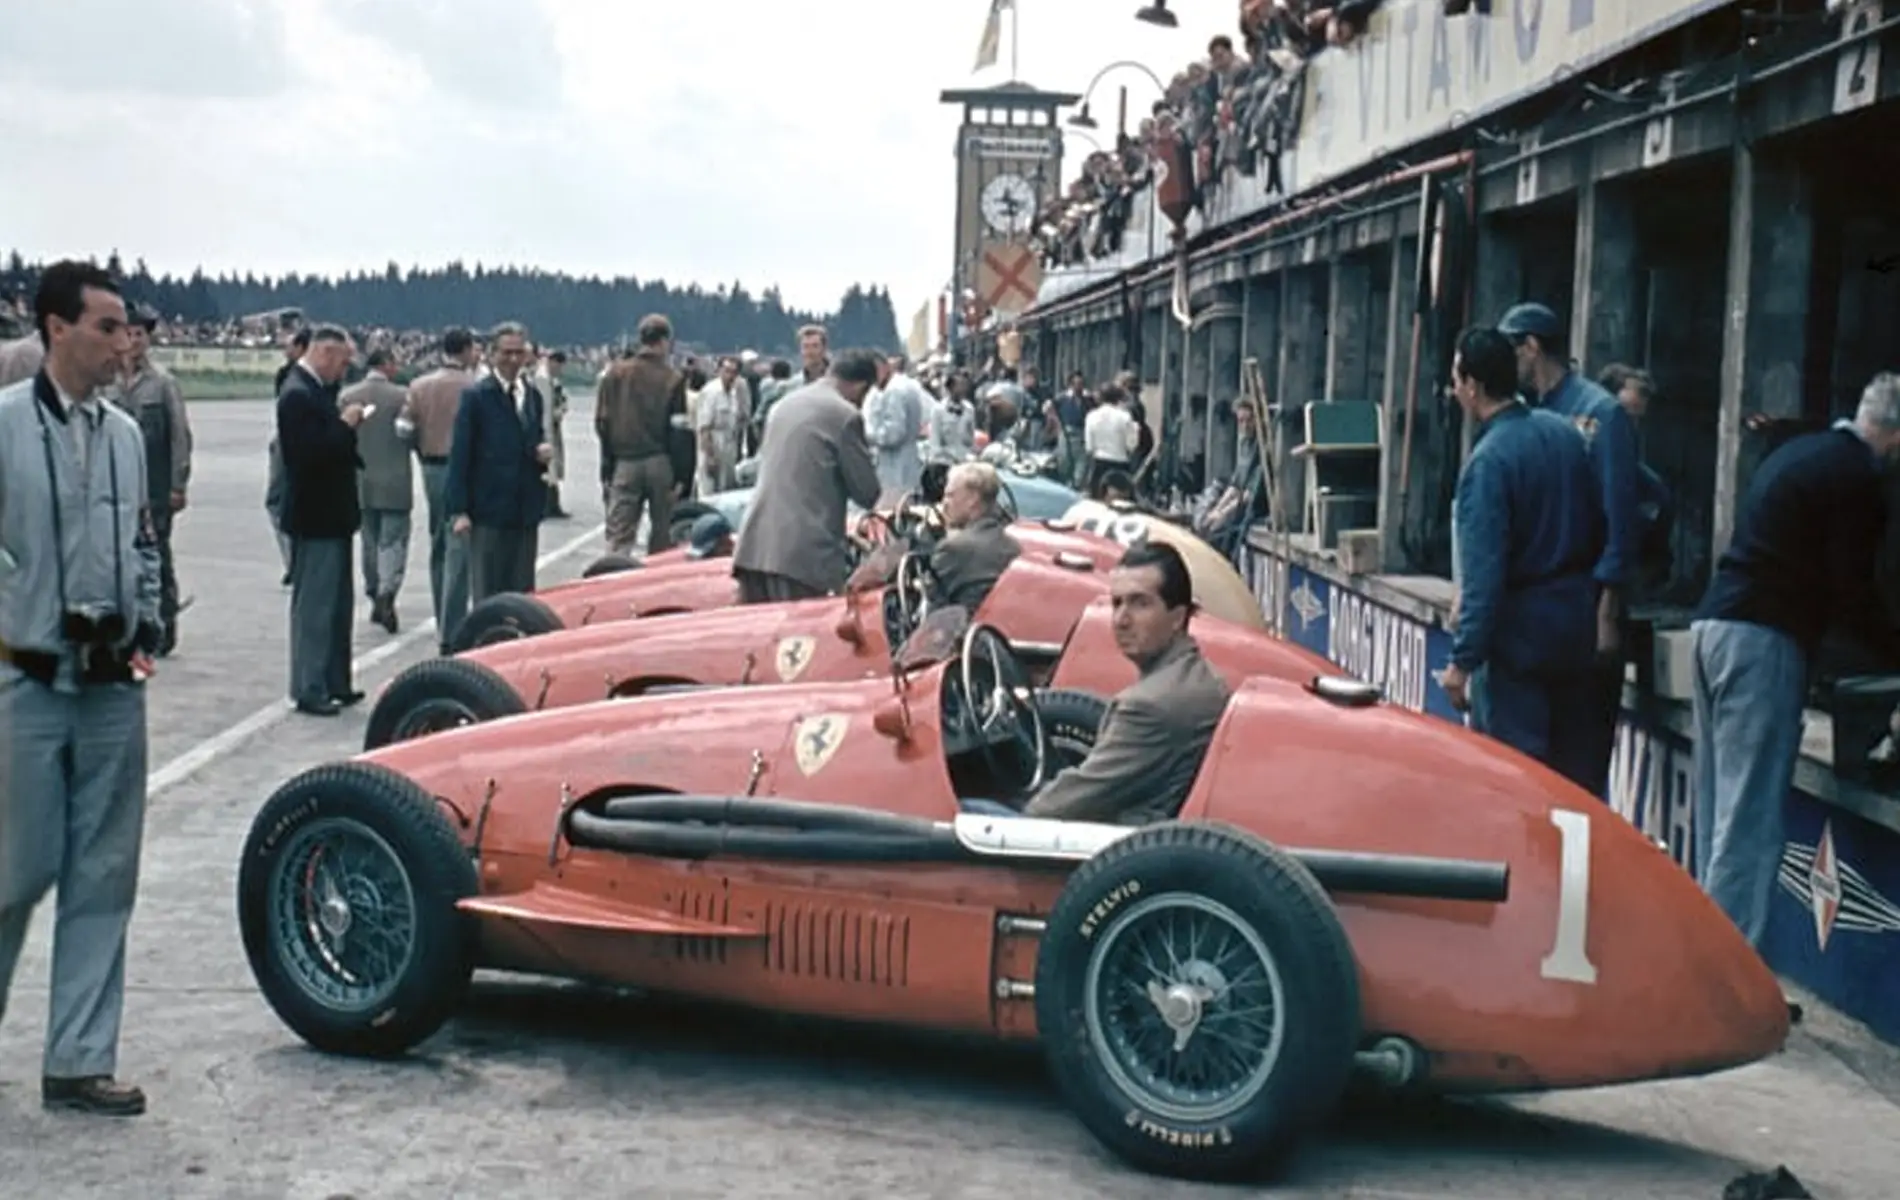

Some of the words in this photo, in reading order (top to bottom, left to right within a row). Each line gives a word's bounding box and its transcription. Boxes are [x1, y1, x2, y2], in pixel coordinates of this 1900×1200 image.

[1358, 0, 1595, 142] VITAMO
[1328, 583, 1427, 714] BORGWARD
[1080, 879, 1141, 937] STELVIO
[1541, 808, 1598, 983] 1
[1140, 1120, 1215, 1147] PIRELLI
